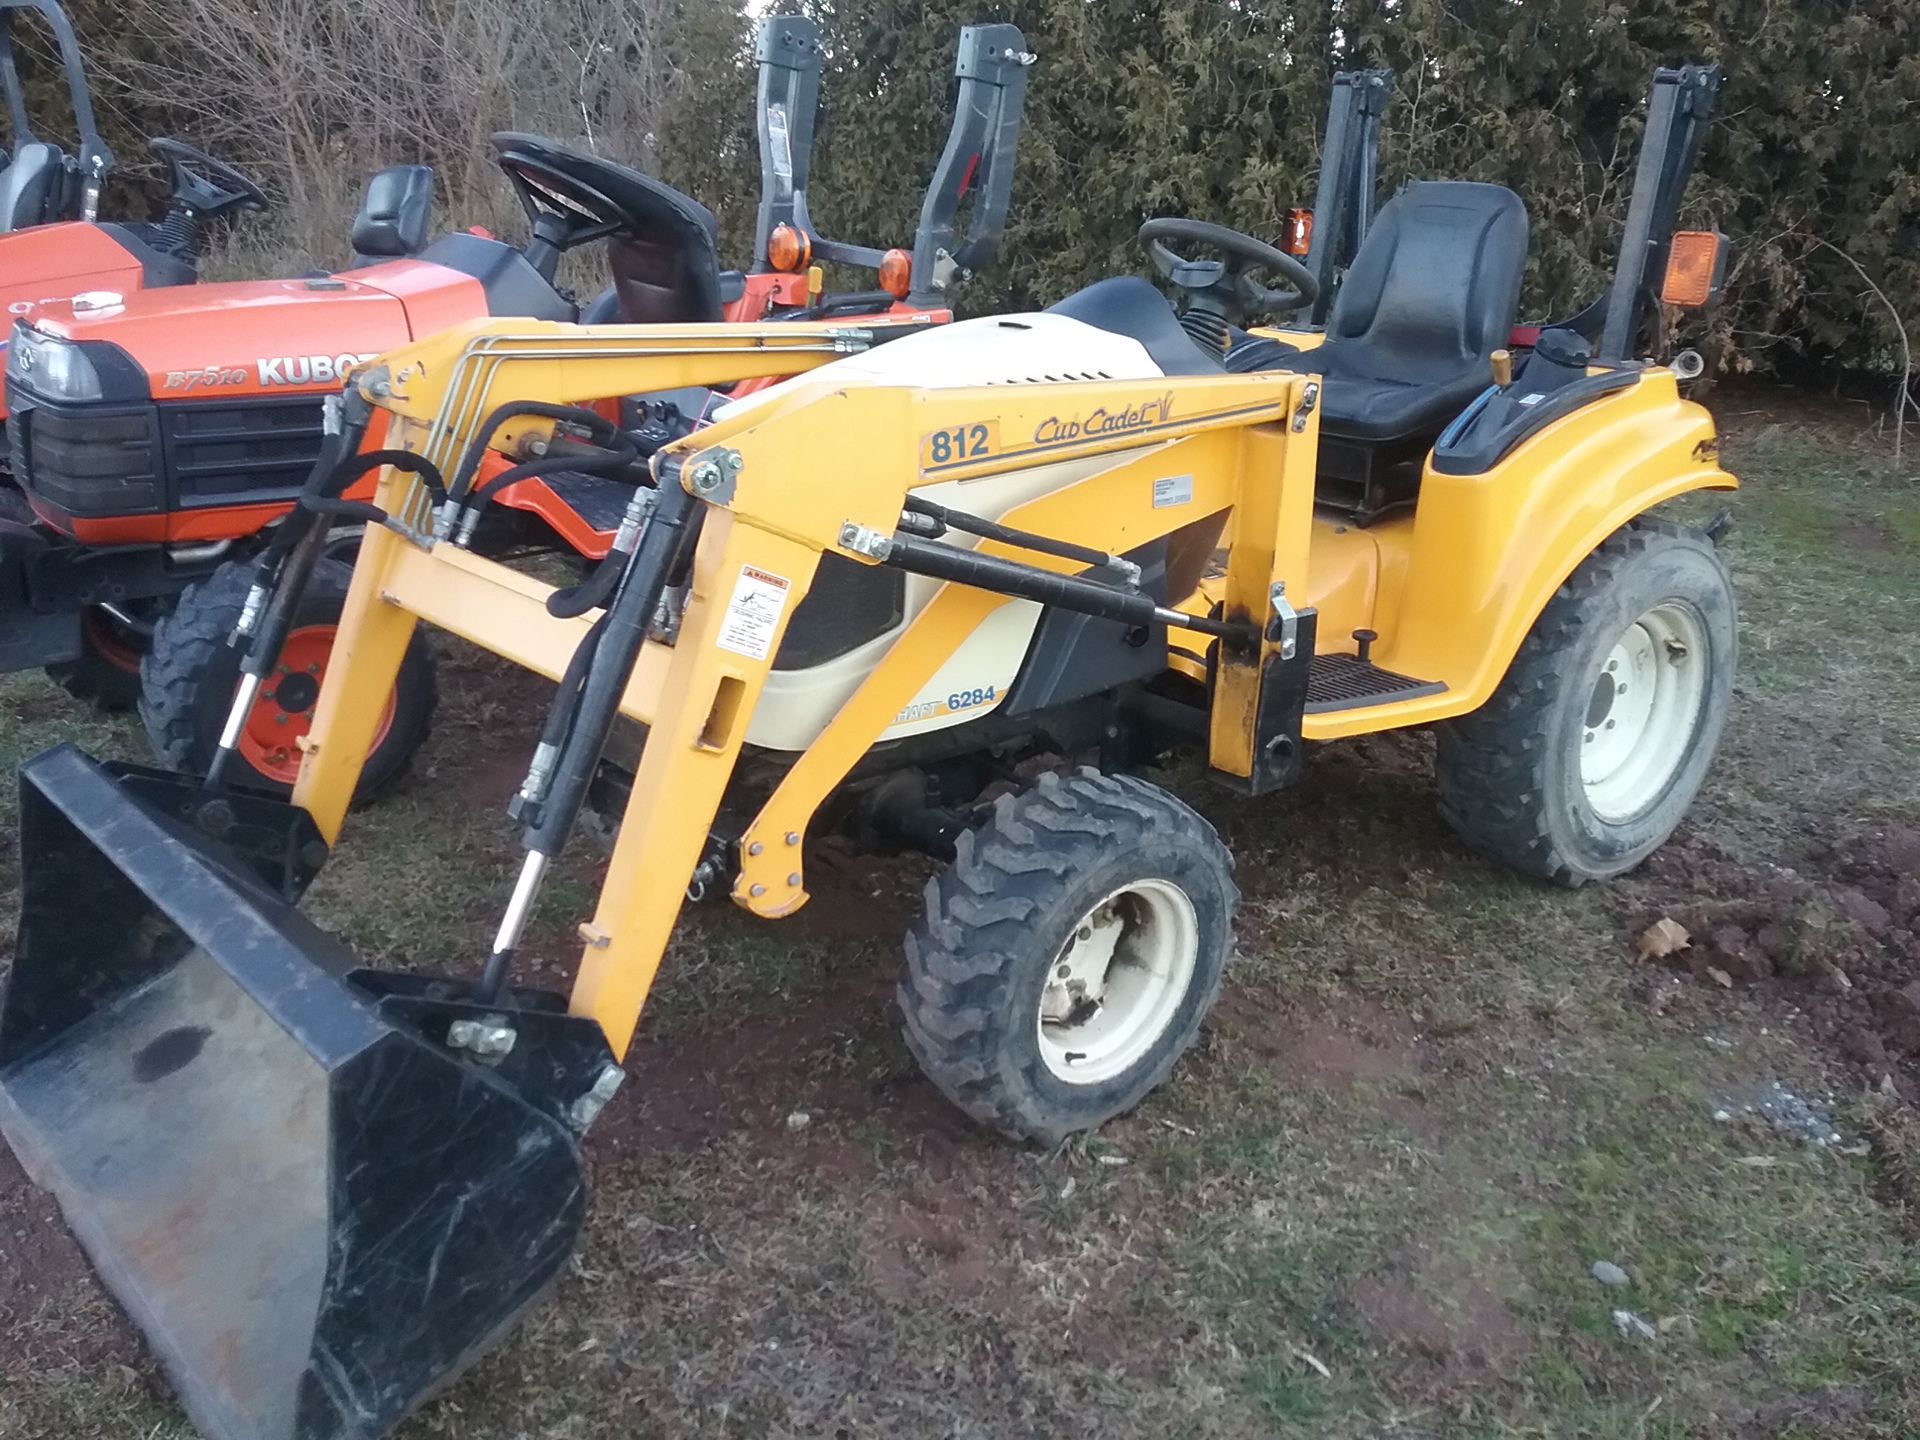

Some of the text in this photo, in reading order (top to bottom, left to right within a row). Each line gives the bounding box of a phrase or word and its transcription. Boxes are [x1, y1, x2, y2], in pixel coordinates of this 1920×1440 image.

[163, 366, 248, 391] B7510
[931, 424, 989, 463] 812
[1034, 414, 1081, 445] Cub
[754, 572, 784, 587] WARNING
[894, 685, 996, 721] HAFT 6284
